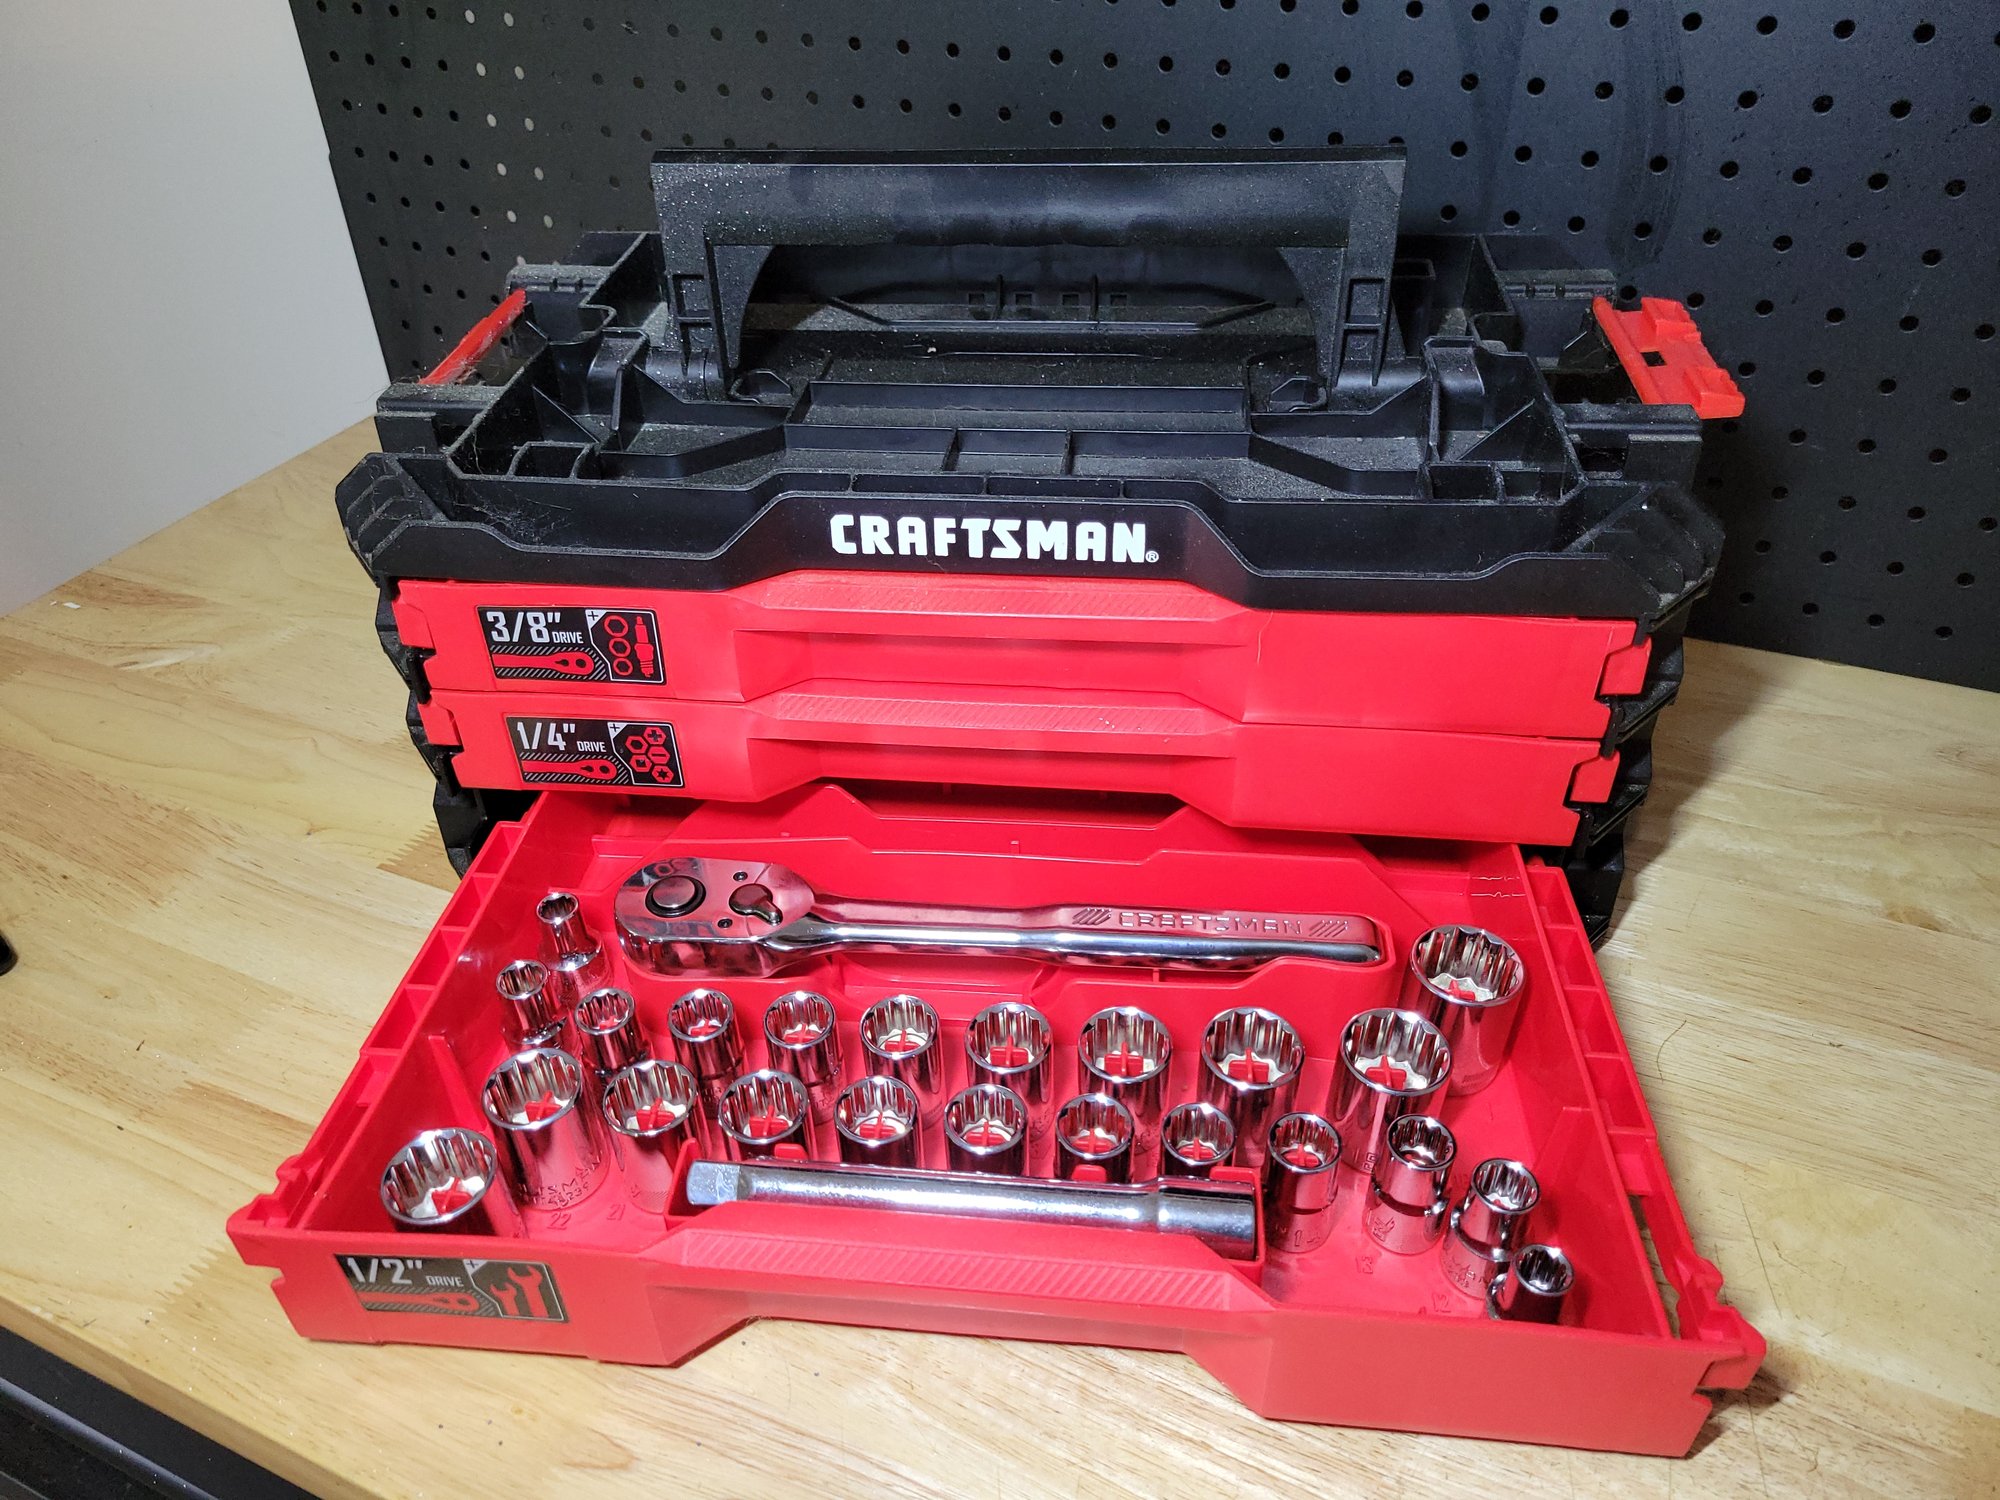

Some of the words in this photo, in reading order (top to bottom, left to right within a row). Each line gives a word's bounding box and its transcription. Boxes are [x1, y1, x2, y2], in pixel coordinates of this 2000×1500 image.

[486, 611, 562, 643] 3/8"
[551, 631, 584, 644] DRIVE
[516, 721, 575, 750] 1/4"
[576, 741, 606, 752] DRIVE
[1119, 911, 1301, 935] CRAFTSMAN
[347, 1256, 422, 1285] 1/2"
[425, 1275, 464, 1287] DRIVE
